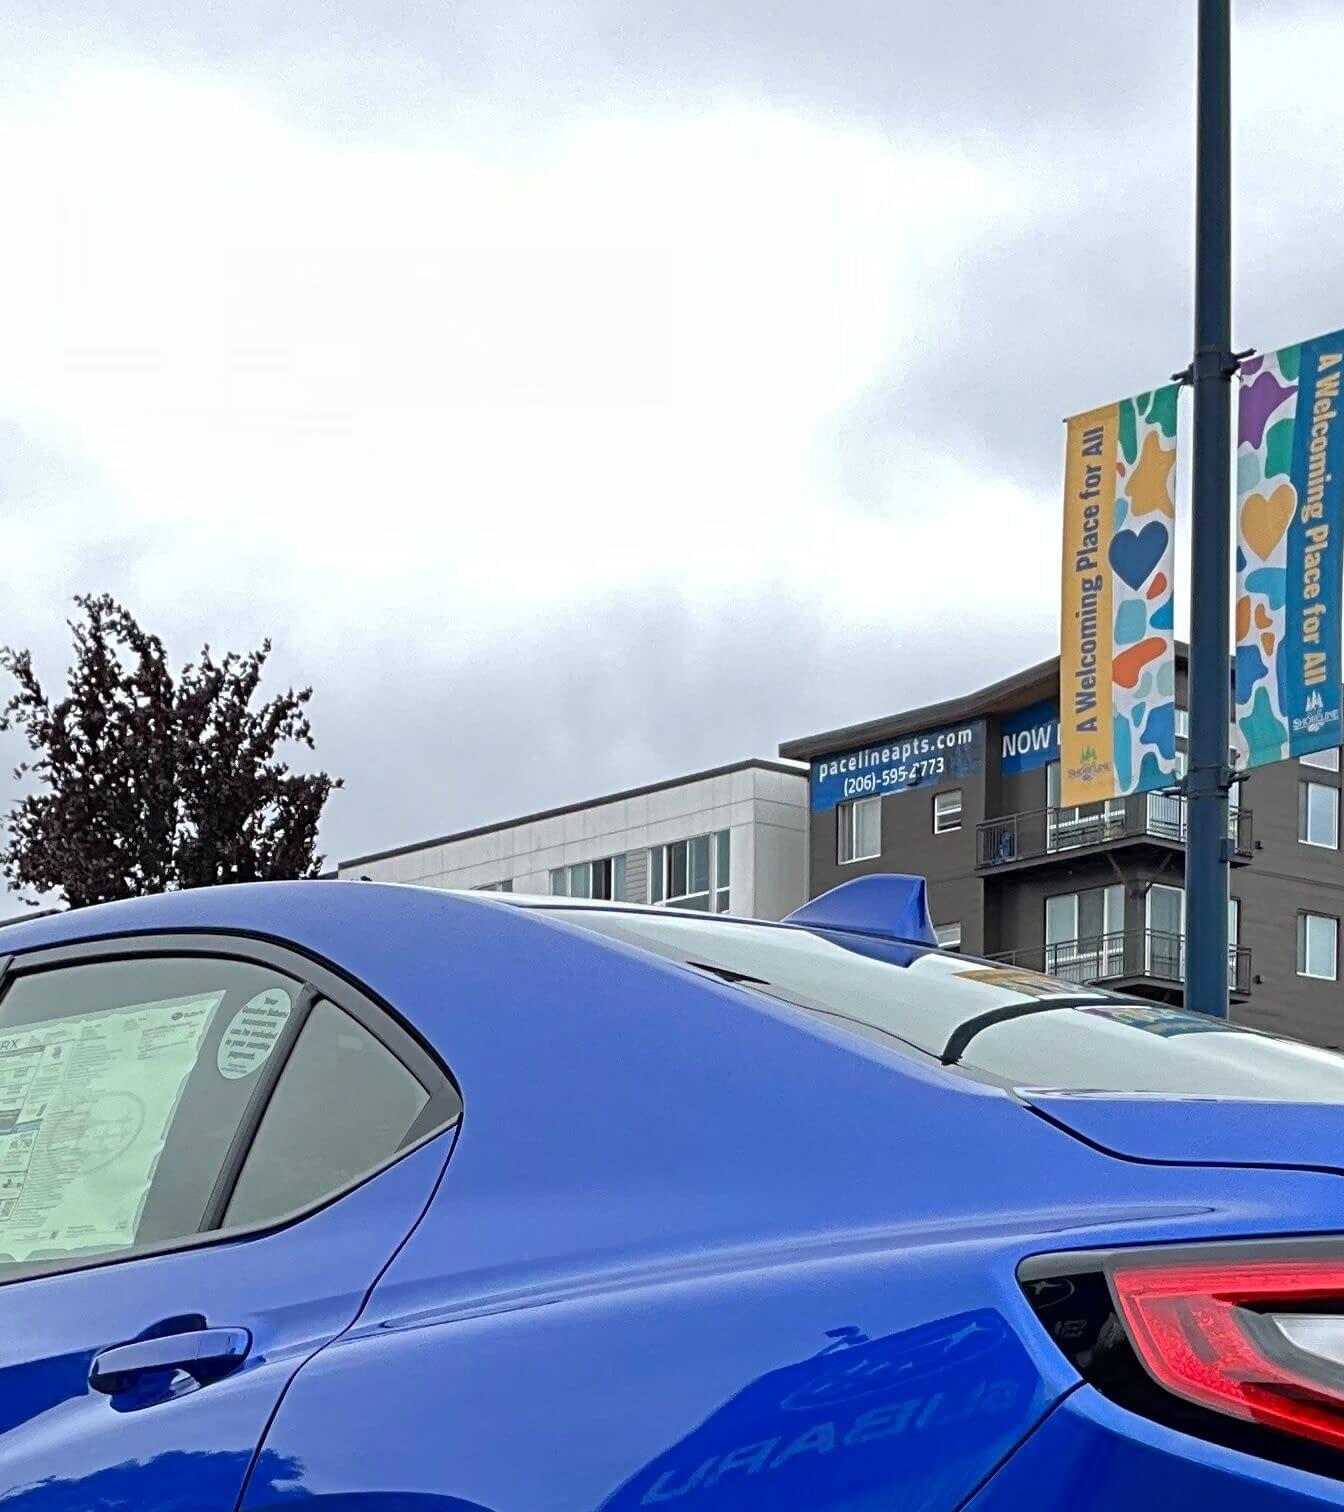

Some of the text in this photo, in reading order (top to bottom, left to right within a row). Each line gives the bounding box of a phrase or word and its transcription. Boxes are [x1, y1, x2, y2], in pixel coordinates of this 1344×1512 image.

[1075, 425, 1104, 733] A Welcoming Place for All
[1301, 353, 1343, 686] A Welcoming Place for All
[819, 728, 973, 782] pacelineapts.com
[1002, 724, 1052, 758] NOW
